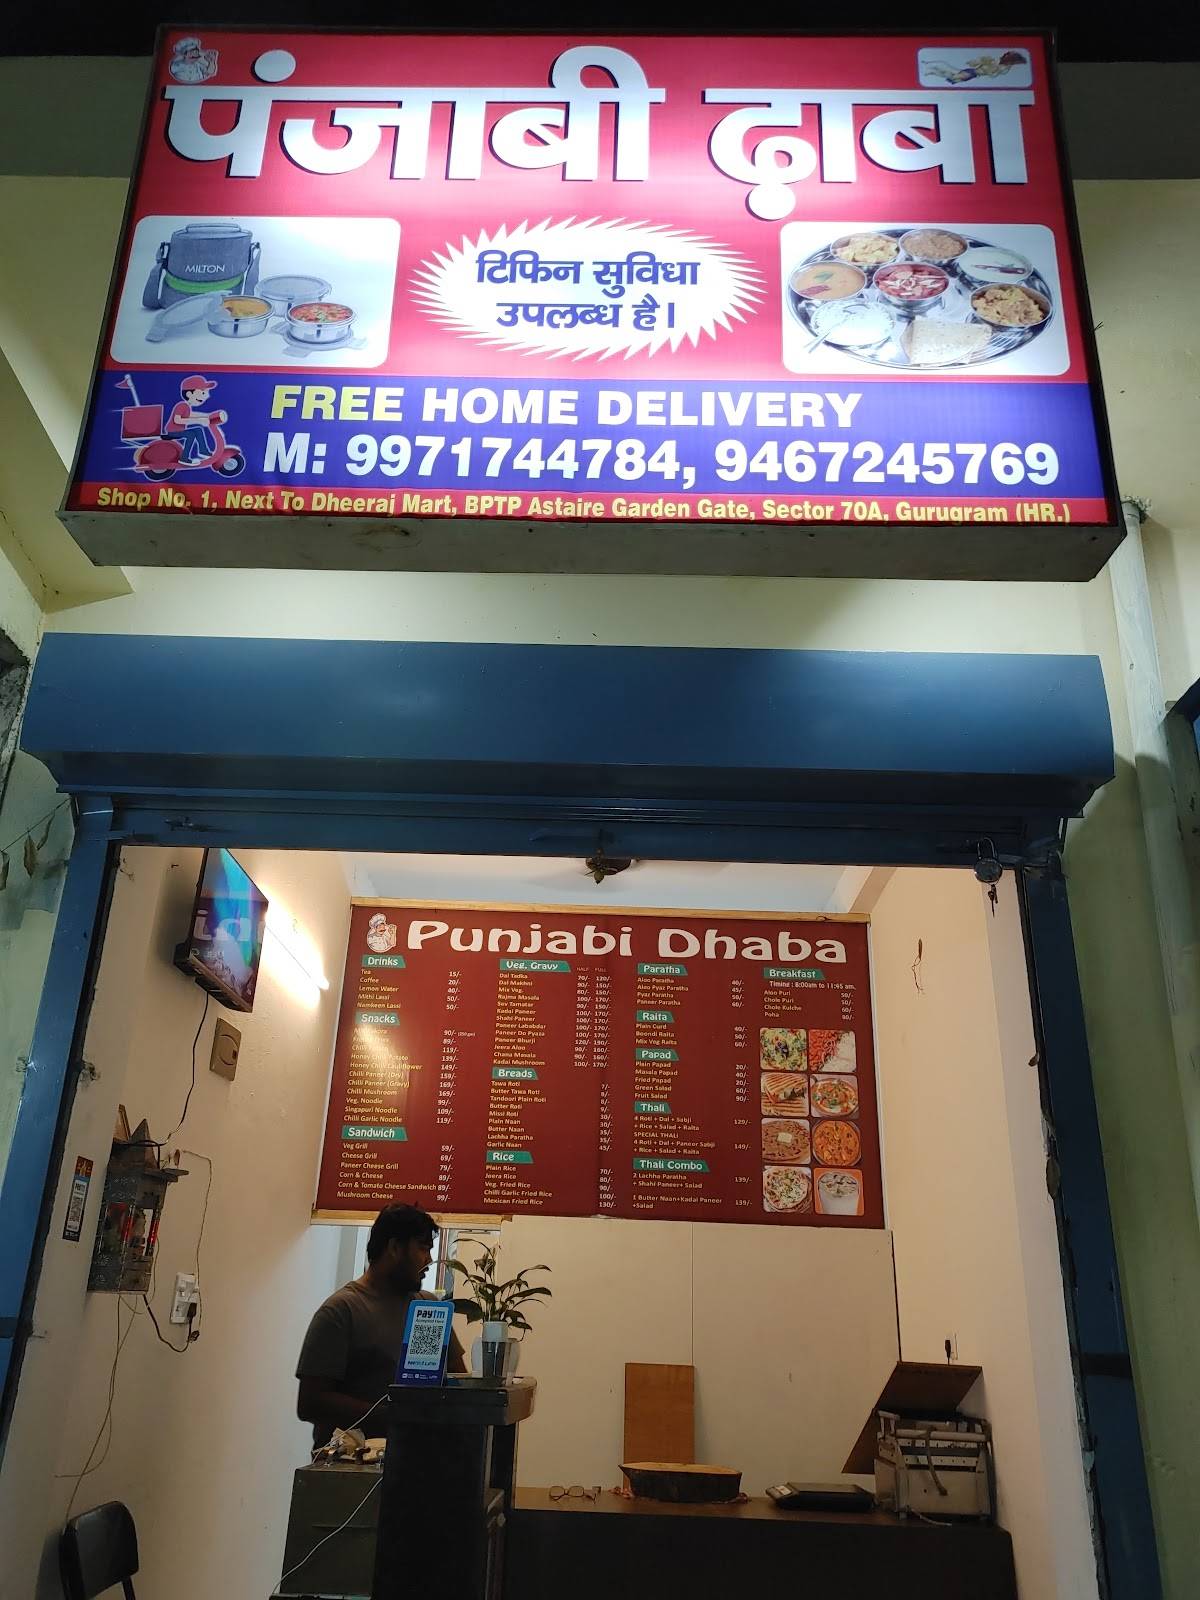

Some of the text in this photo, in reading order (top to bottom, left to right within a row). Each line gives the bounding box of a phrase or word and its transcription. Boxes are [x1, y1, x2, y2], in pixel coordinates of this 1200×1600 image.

[163, 45, 666, 183] पंजाबी
[184, 263, 226, 275] MILTON
[476, 250, 701, 299] टिफिन सुविधा
[496, 303, 623, 329] उपलब्ध
[270, 384, 863, 428] FREE HOME DELIVERY
[263, 432, 1060, 489] M: 9971744784, 9467245769
[98, 487, 1071, 526] Shop No. 1, Next To Dheeraj Mart, BPTP Astaire Garden Gate, Sector 70A, Gurugram (HR.)
[407, 920, 847, 963] Punjabi Dhaba
[368, 957, 399, 966] Drinks
[506, 961, 558, 971] Veg. Gravy
[644, 965, 680, 974] Paratha
[769, 969, 816, 978] Breakfast
[362, 1014, 396, 1024] Snacks
[642, 1013, 667, 1021] Raita
[641, 1050, 671, 1060] Papad
[499, 1069, 532, 1078] Breads
[640, 1104, 664, 1112] Thali
[348, 1127, 395, 1138] Sandwich
[493, 1152, 514, 1161] Rice
[640, 1160, 703, 1170] Thali Combo
